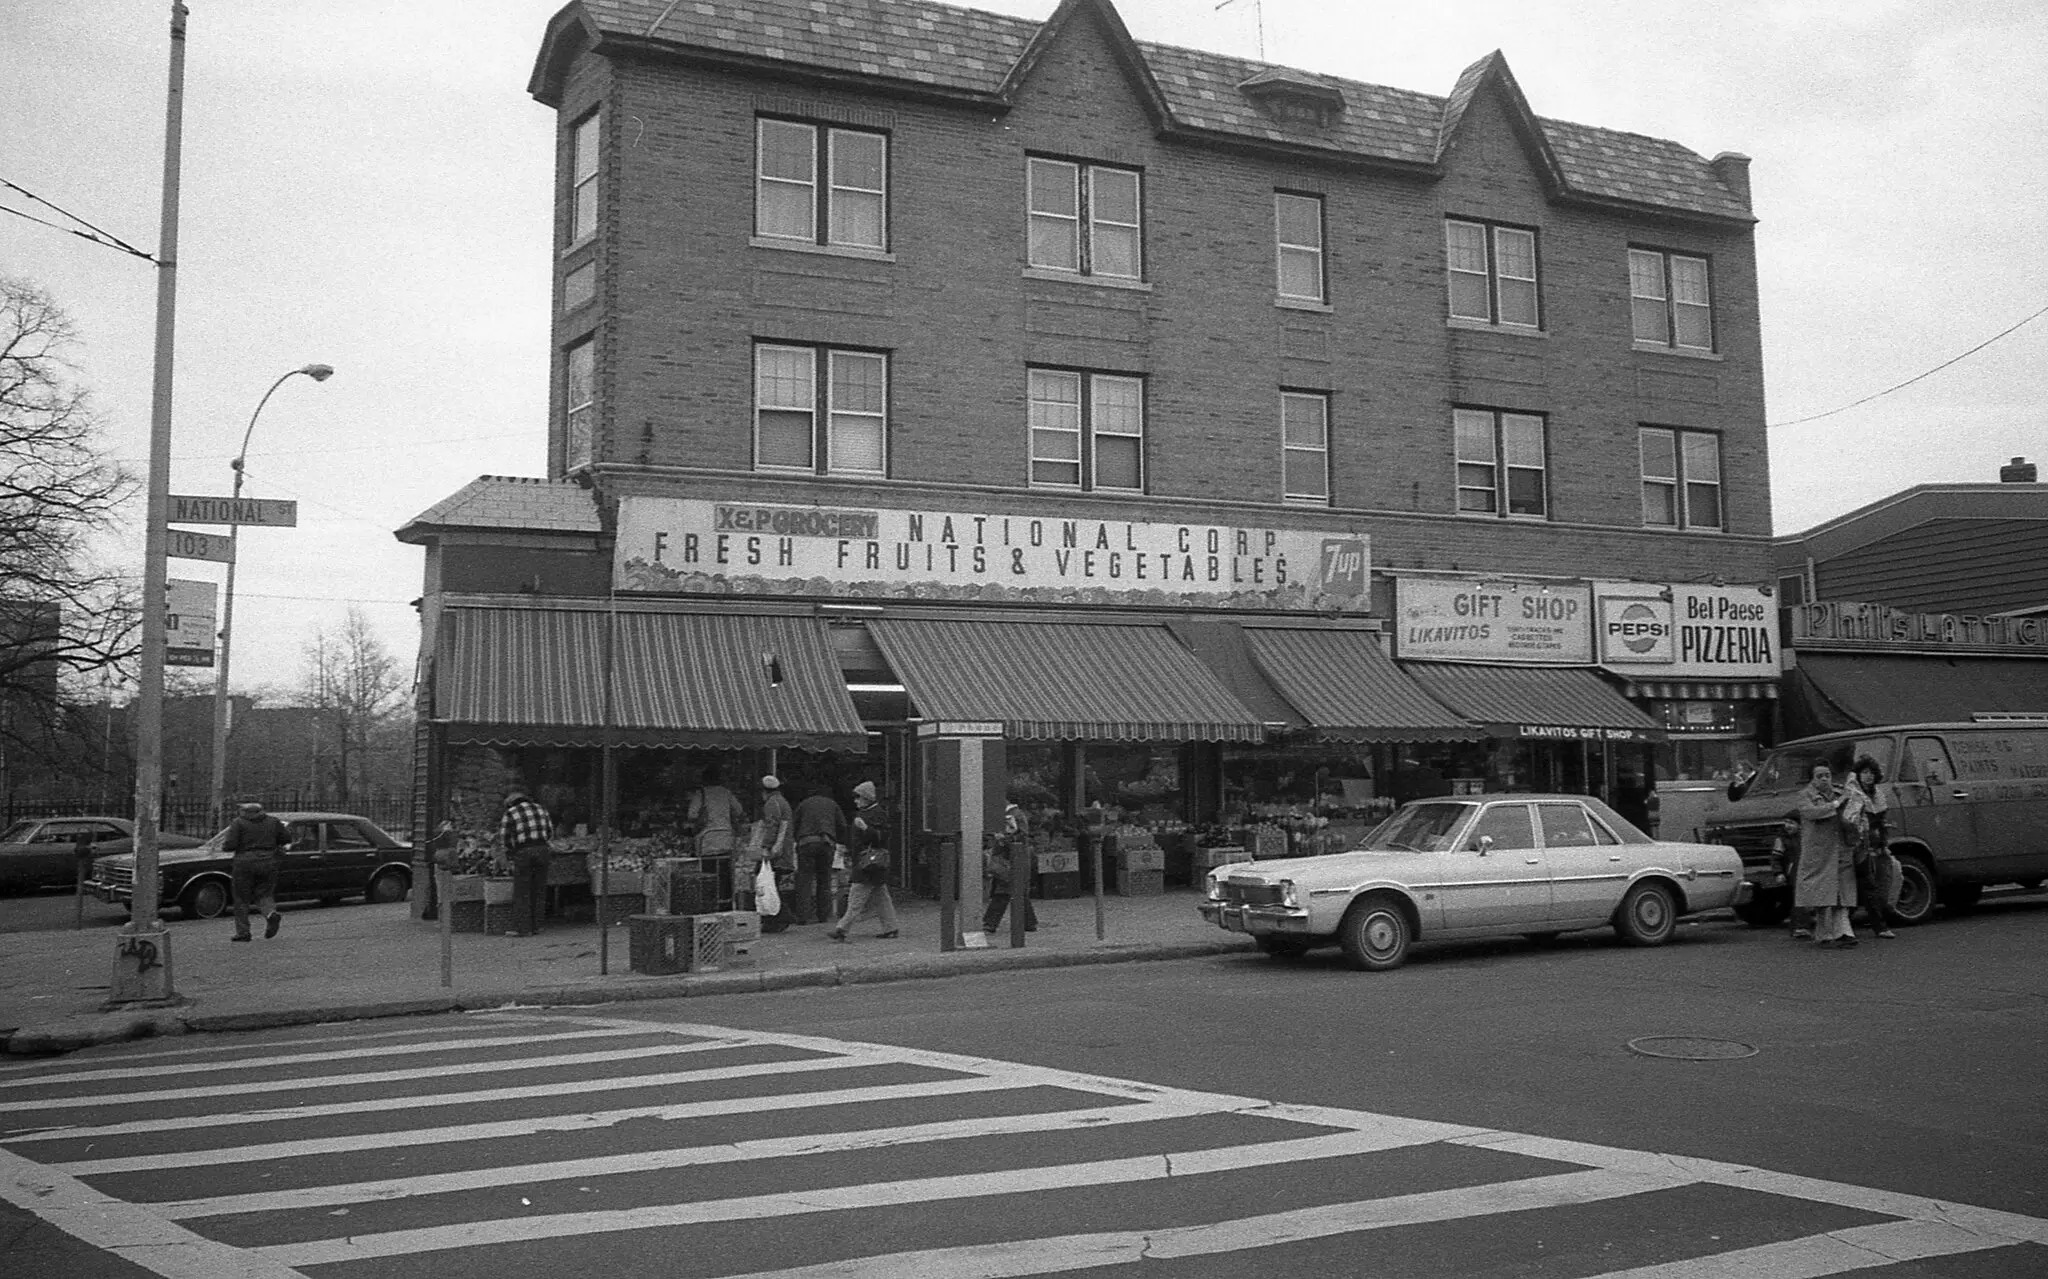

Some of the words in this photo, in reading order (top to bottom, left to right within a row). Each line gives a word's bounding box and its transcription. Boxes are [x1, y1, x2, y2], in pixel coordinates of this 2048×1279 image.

[177, 499, 266, 523] NATIONAL
[278, 504, 293, 515] ST
[772, 510, 878, 537] GROCERY
[175, 534, 208, 556] 103
[218, 539, 230, 551] ST
[909, 514, 1136, 550] NATIONAL
[1178, 526, 1283, 557] CORP.
[655, 532, 792, 566] FRESH
[838, 540, 986, 573] FRUITS
[1012, 548, 1026, 575] &
[1056, 549, 1287, 584] VEGETABLES
[1453, 593, 1502, 617] GIFT
[1521, 595, 1578, 621] SHOP
[1687, 595, 1715, 620] Bel
[1718, 597, 1764, 622] Paese
[1409, 624, 1491, 644] LIKAVITOS
[1608, 622, 1669, 637] PEPSI
[1801, 602, 1909, 641] Phil's
[1681, 625, 1773, 664] PIZZERIA
[1519, 725, 1578, 738] LIKAVITOS
[1580, 728, 1602, 740] GIFT
[1605, 729, 1633, 740] SHOP
